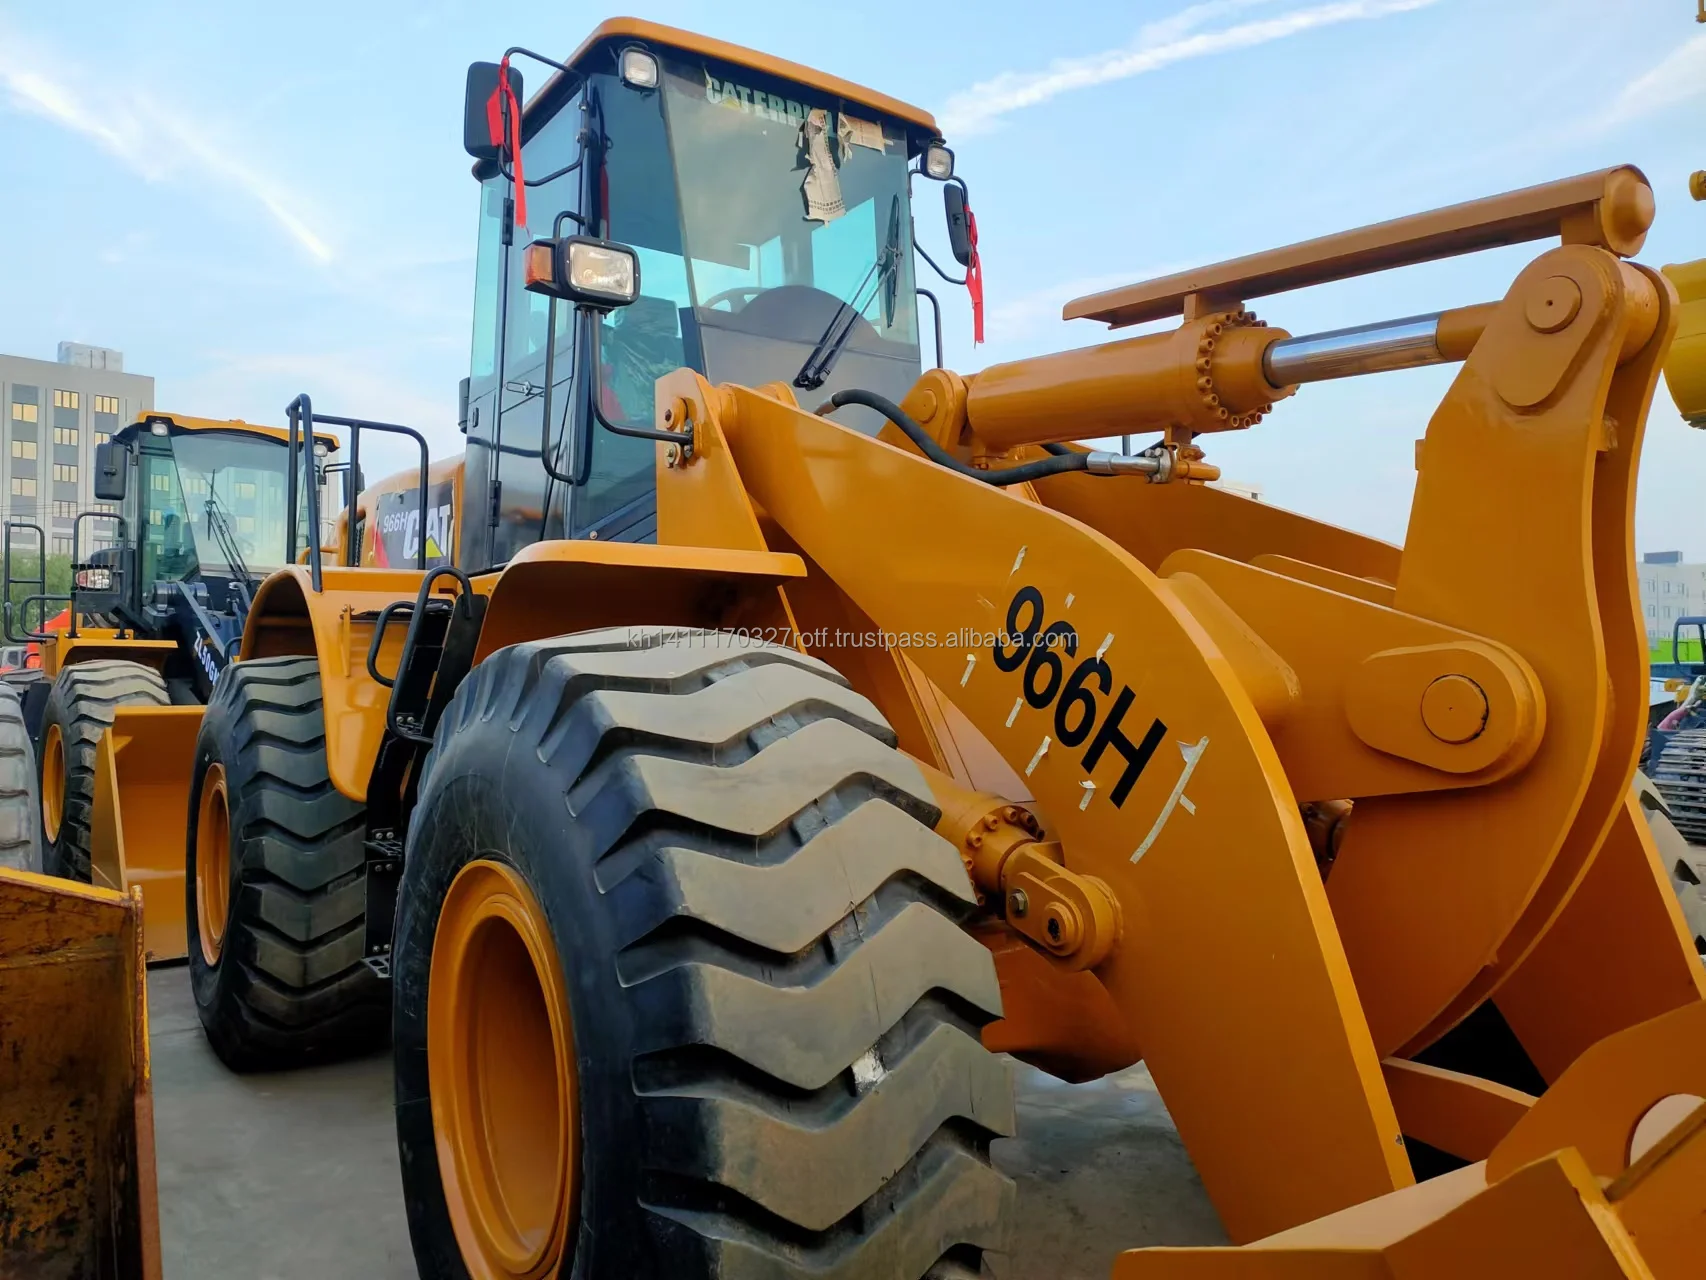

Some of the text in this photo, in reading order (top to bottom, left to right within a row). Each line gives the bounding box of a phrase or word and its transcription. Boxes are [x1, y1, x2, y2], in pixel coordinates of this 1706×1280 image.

[383, 511, 408, 533] 966H
[403, 503, 451, 560] CAT
[993, 586, 1168, 810] 966H
